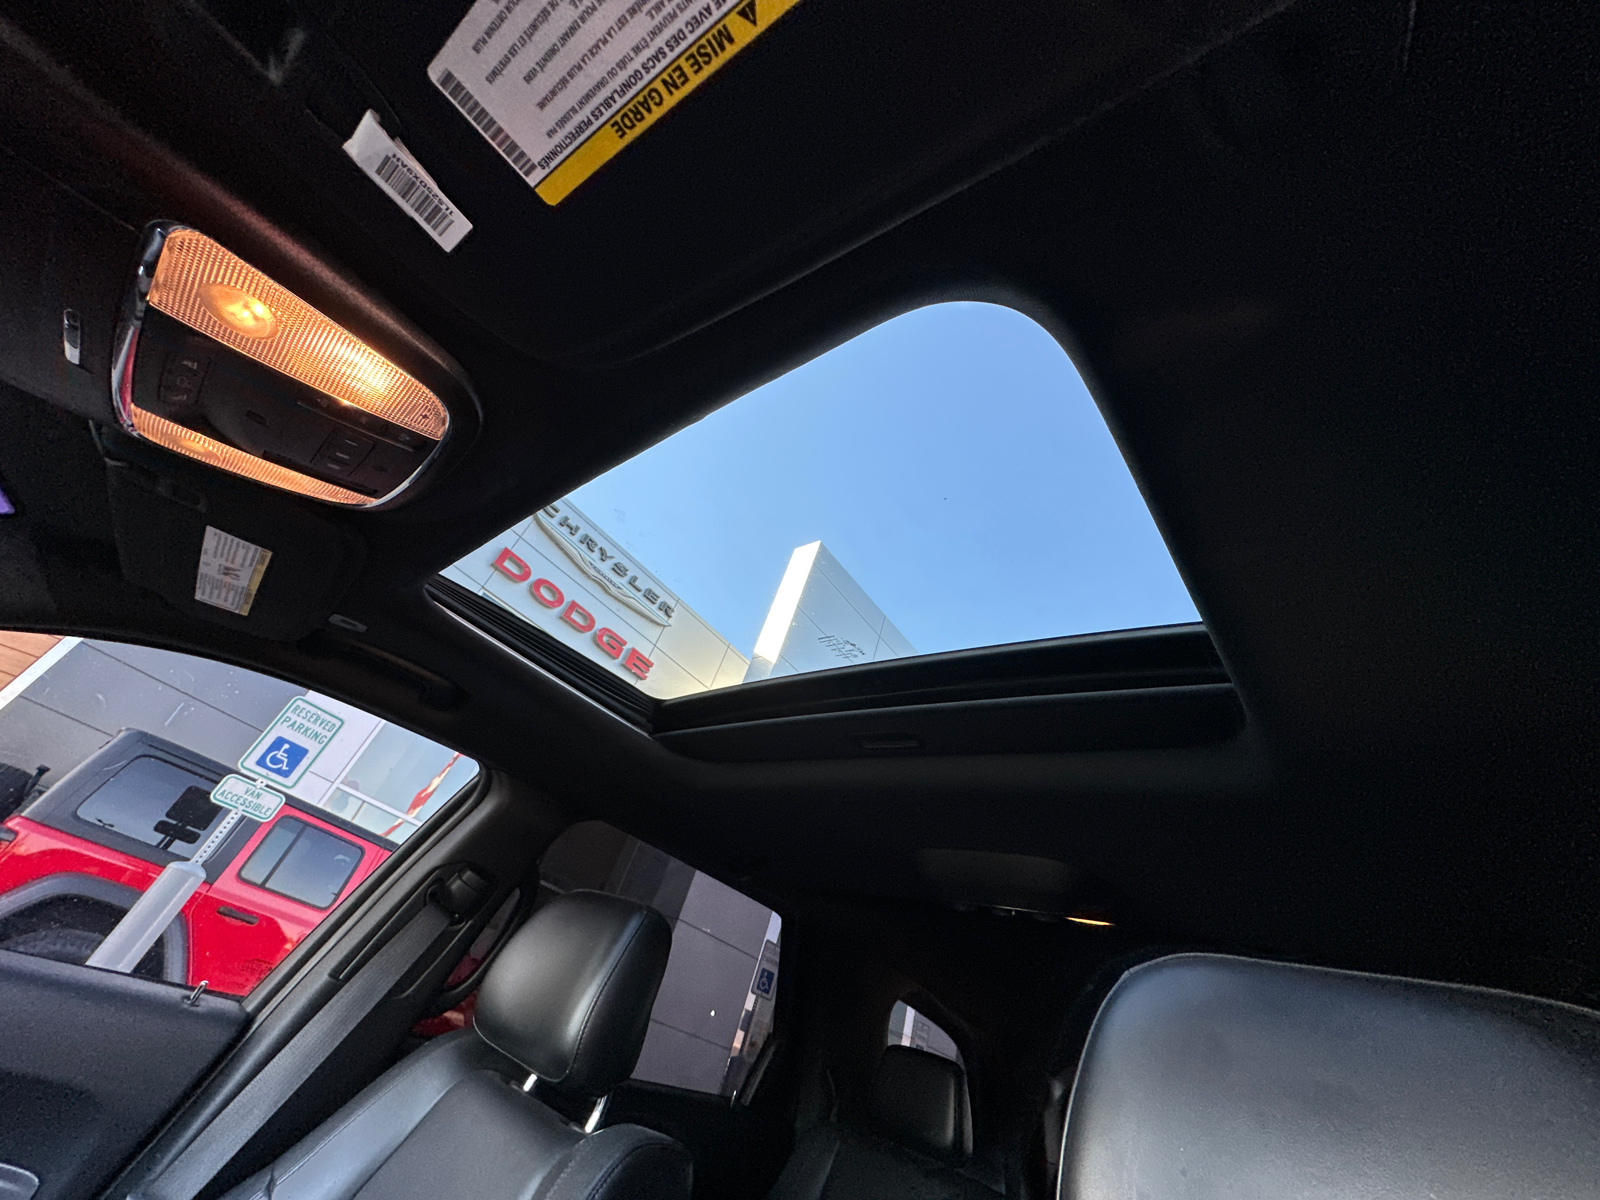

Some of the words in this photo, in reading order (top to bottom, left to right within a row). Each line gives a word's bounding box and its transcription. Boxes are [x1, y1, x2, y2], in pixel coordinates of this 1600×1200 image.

[483, 9, 507, 40] OBTENIR
[523, 6, 551, 43] SÉCURITÉ
[577, 1, 597, 24] POUR
[614, 14, 628, 31] EST
[646, 8, 678, 42] PEUVENT
[683, 3, 713, 35] AVEC
[471, 36, 487, 55] PLUS
[517, 34, 527, 48] ET
[557, 19, 581, 48] ENFANT
[587, 34, 608, 58] PLACE
[606, 26, 617, 39] LA
[664, 28, 687, 53] DES
[507, 42, 520, 58] LES
[580, 53, 590, 65] LA
[631, 37, 649, 57] ÊTRE
[640, 46, 668, 75] SACS
[684, 24, 736, 75] MISE
[566, 61, 582, 80] PLUS
[606, 66, 618, 80] OU
[615, 52, 634, 71] TUÉS
[523, 66, 539, 85] VERS
[660, 64, 690, 96] EN
[536, 75, 569, 111] SÉCURITAIRE
[575, 76, 609, 110] GRAVEMENT
[590, 68, 644, 121] GONFLABLES
[555, 106, 578, 129] BLESSÉS
[609, 86, 665, 139] GARDE
[537, 116, 593, 171] PERFECTIONNÉS
[545, 126, 557, 139] PAR
[491, 547, 654, 681] DODGE
[280, 716, 328, 746] PARKING
[291, 704, 337, 734] RESERVED
[218, 788, 272, 817] ACCESSIBLE
[244, 787, 262, 801] VAN
